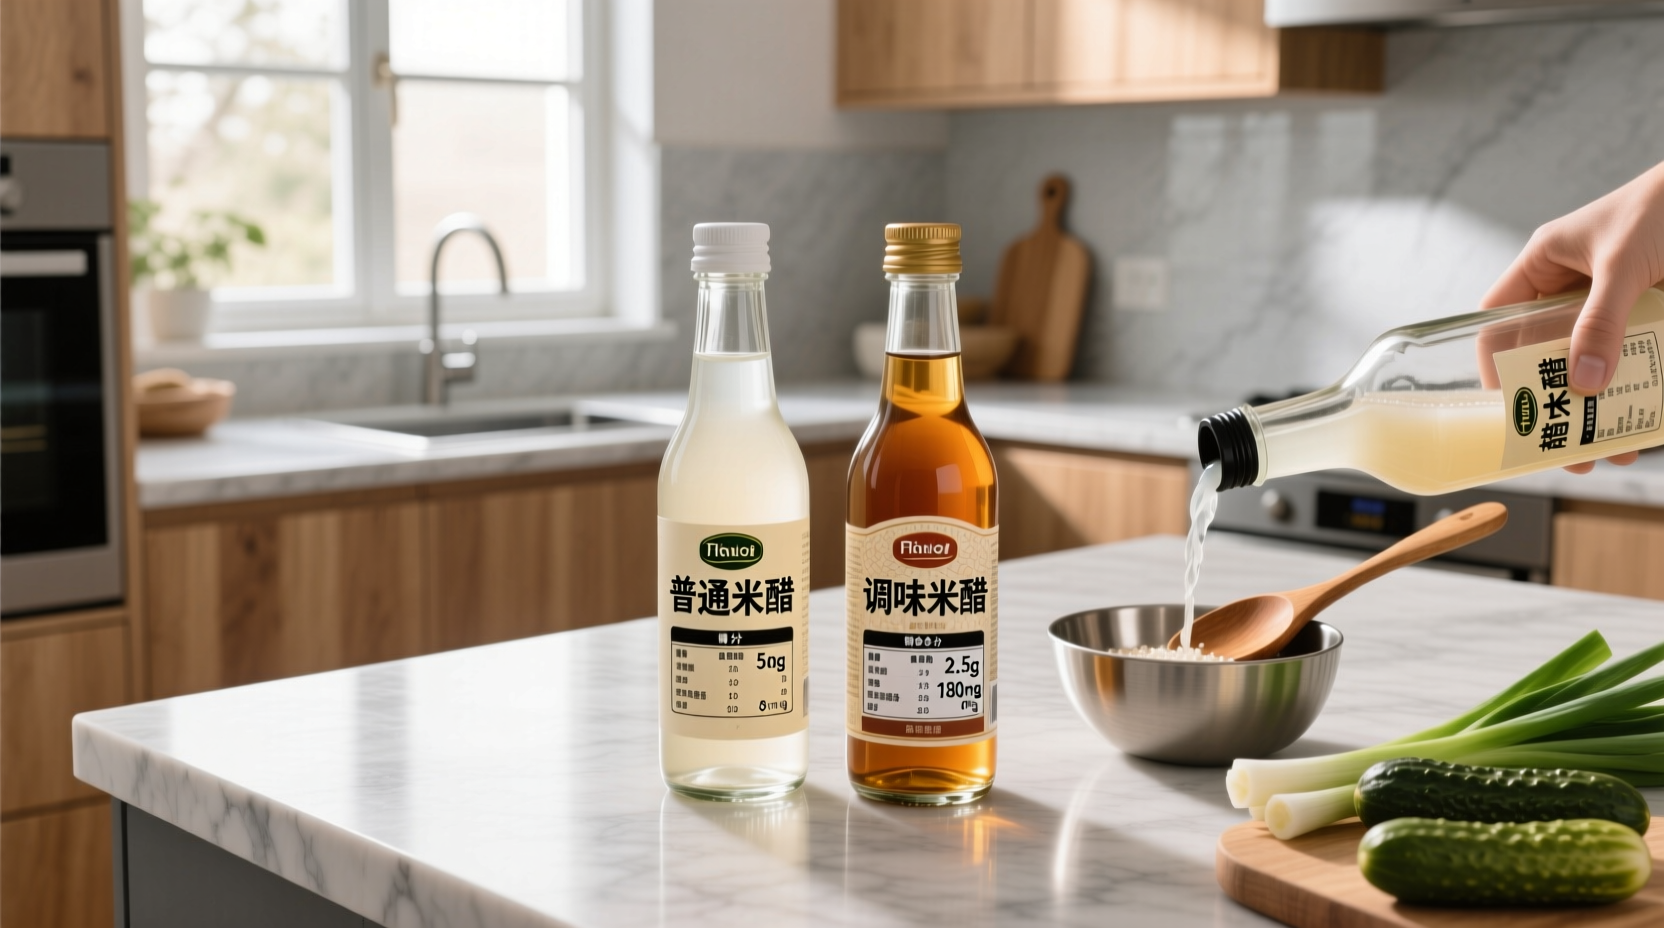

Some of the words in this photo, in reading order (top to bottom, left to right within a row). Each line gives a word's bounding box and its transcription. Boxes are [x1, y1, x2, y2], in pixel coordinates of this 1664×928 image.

[670, 575, 795, 616] 普通米醋
[863, 576, 988, 617] 调味米醋
[944, 655, 980, 678] 2.5g
